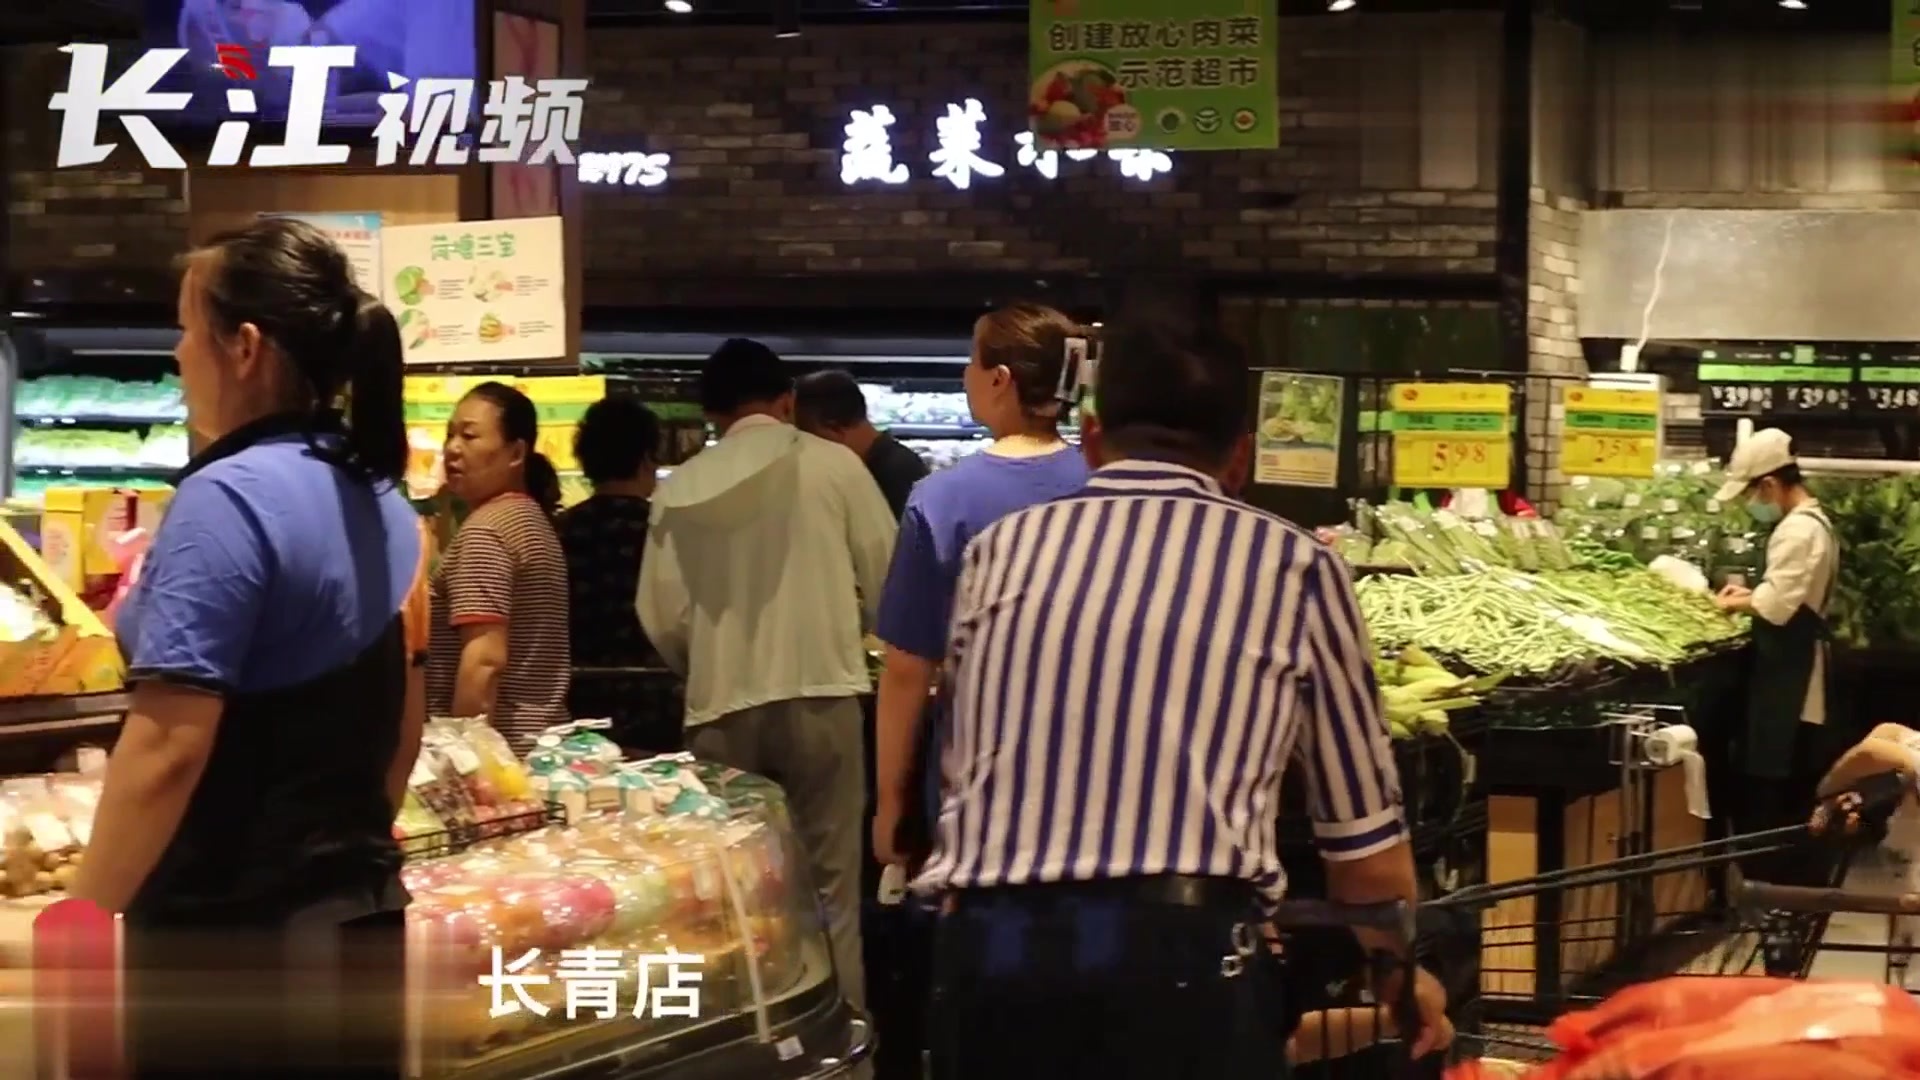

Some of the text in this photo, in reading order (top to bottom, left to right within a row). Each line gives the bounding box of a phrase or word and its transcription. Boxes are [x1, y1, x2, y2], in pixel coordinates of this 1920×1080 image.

[1049, 17, 1260, 52] 创建放心肉菜
[1119, 57, 1259, 88] 示范超市
